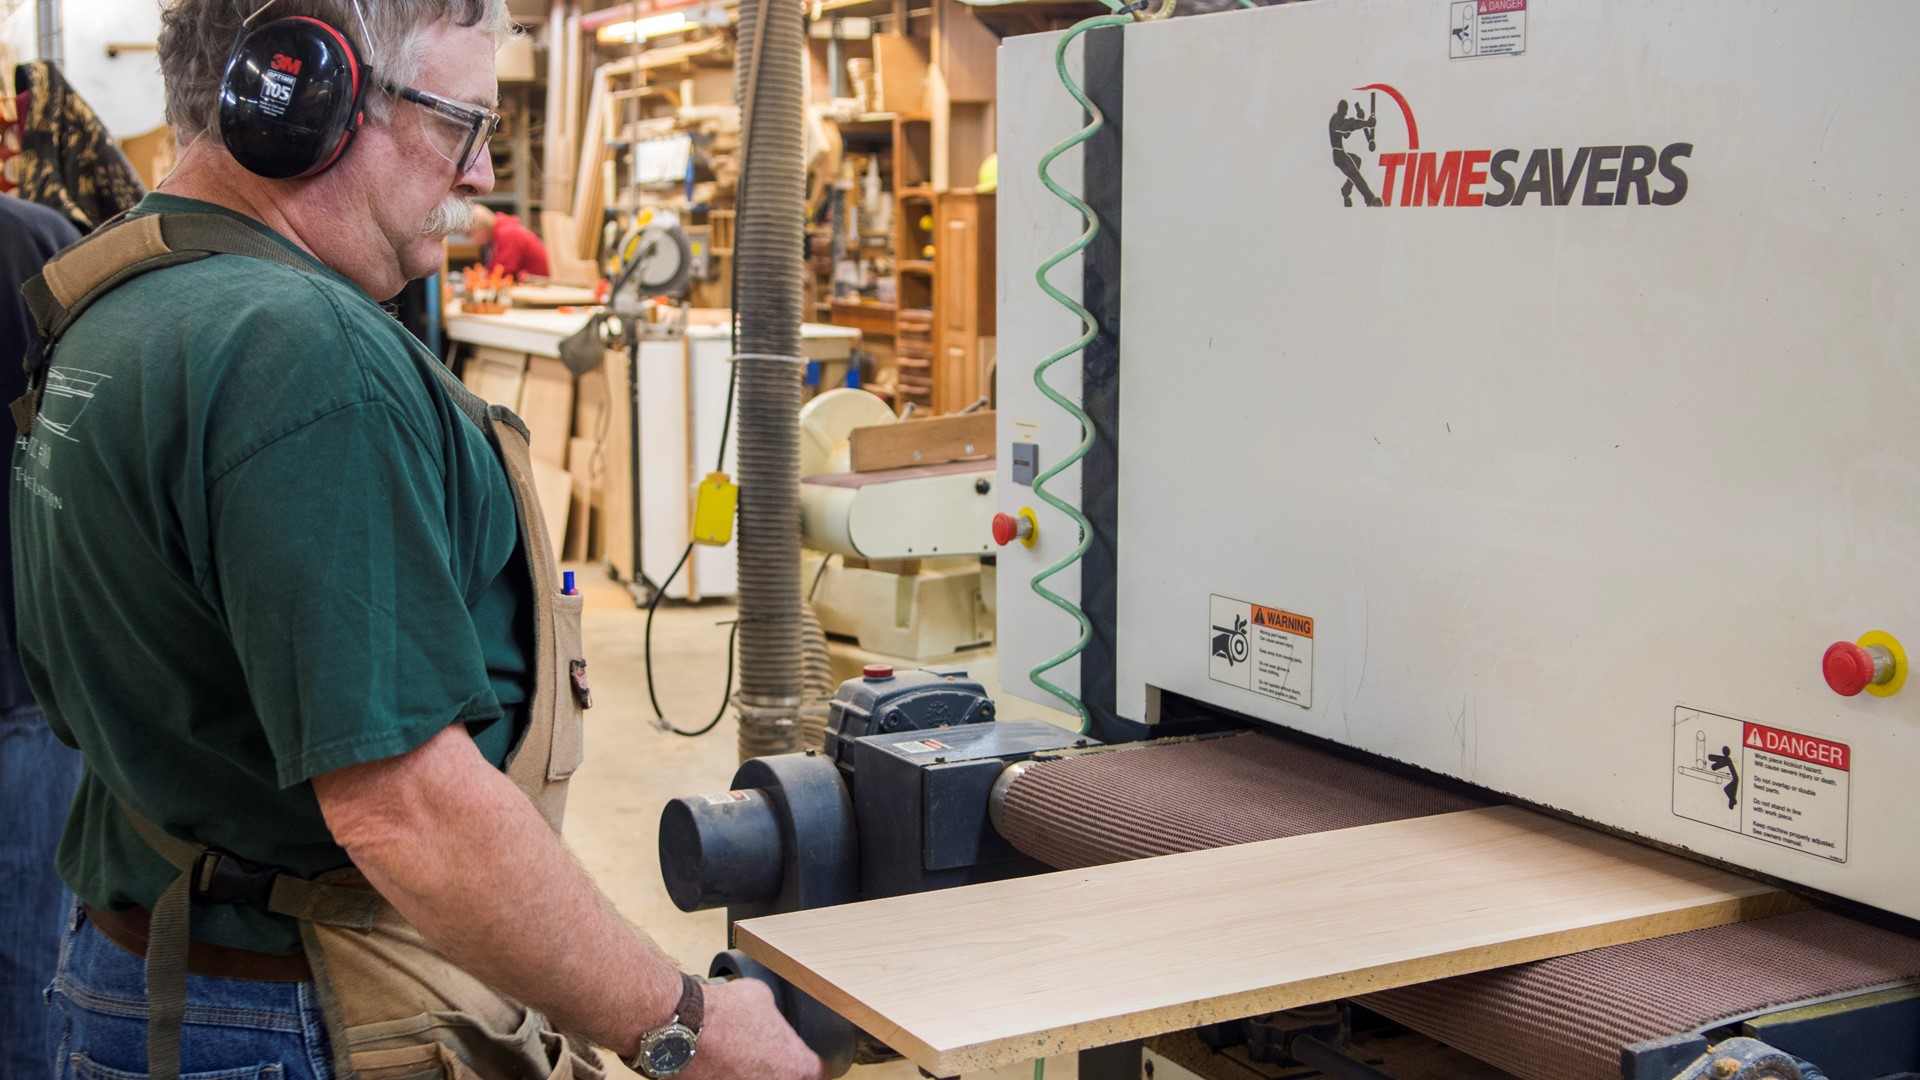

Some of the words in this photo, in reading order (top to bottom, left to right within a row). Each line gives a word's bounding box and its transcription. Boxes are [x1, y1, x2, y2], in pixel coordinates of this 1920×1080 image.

[1489, 0, 1523, 10] DANGER
[271, 53, 302, 75] 3M
[265, 81, 291, 101] 105
[1379, 142, 1694, 207] TIMESAVERS
[1267, 611, 1311, 634] WARNING
[1766, 731, 1843, 765] DANGER
[1754, 753, 1768, 761] Work
[1769, 757, 1783, 765] piece
[1783, 760, 1802, 769] kickout
[1803, 764, 1823, 775] hazard.
[1764, 764, 1780, 772] cause
[1780, 768, 1798, 777] severe
[1798, 771, 1813, 781] injury
[1820, 777, 1838, 786] death.
[1753, 783, 1765, 791] feed
[1765, 786, 1780, 795] parts.
[1771, 780, 1791, 790] overlap
[1798, 786, 1816, 796] double
[1764, 809, 1777, 817] work
[1777, 813, 1794, 822] piece.
[1771, 803, 1786, 812] stand
[1792, 808, 1802, 816] line
[1752, 820, 1766, 830] Keep
[1766, 824, 1788, 835] machine
[1789, 831, 1811, 842] properly
[1811, 836, 1836, 849] adjusted.
[1752, 828, 1763, 836] See
[1763, 832, 1781, 841] owners
[1782, 837, 1803, 847] manual.
